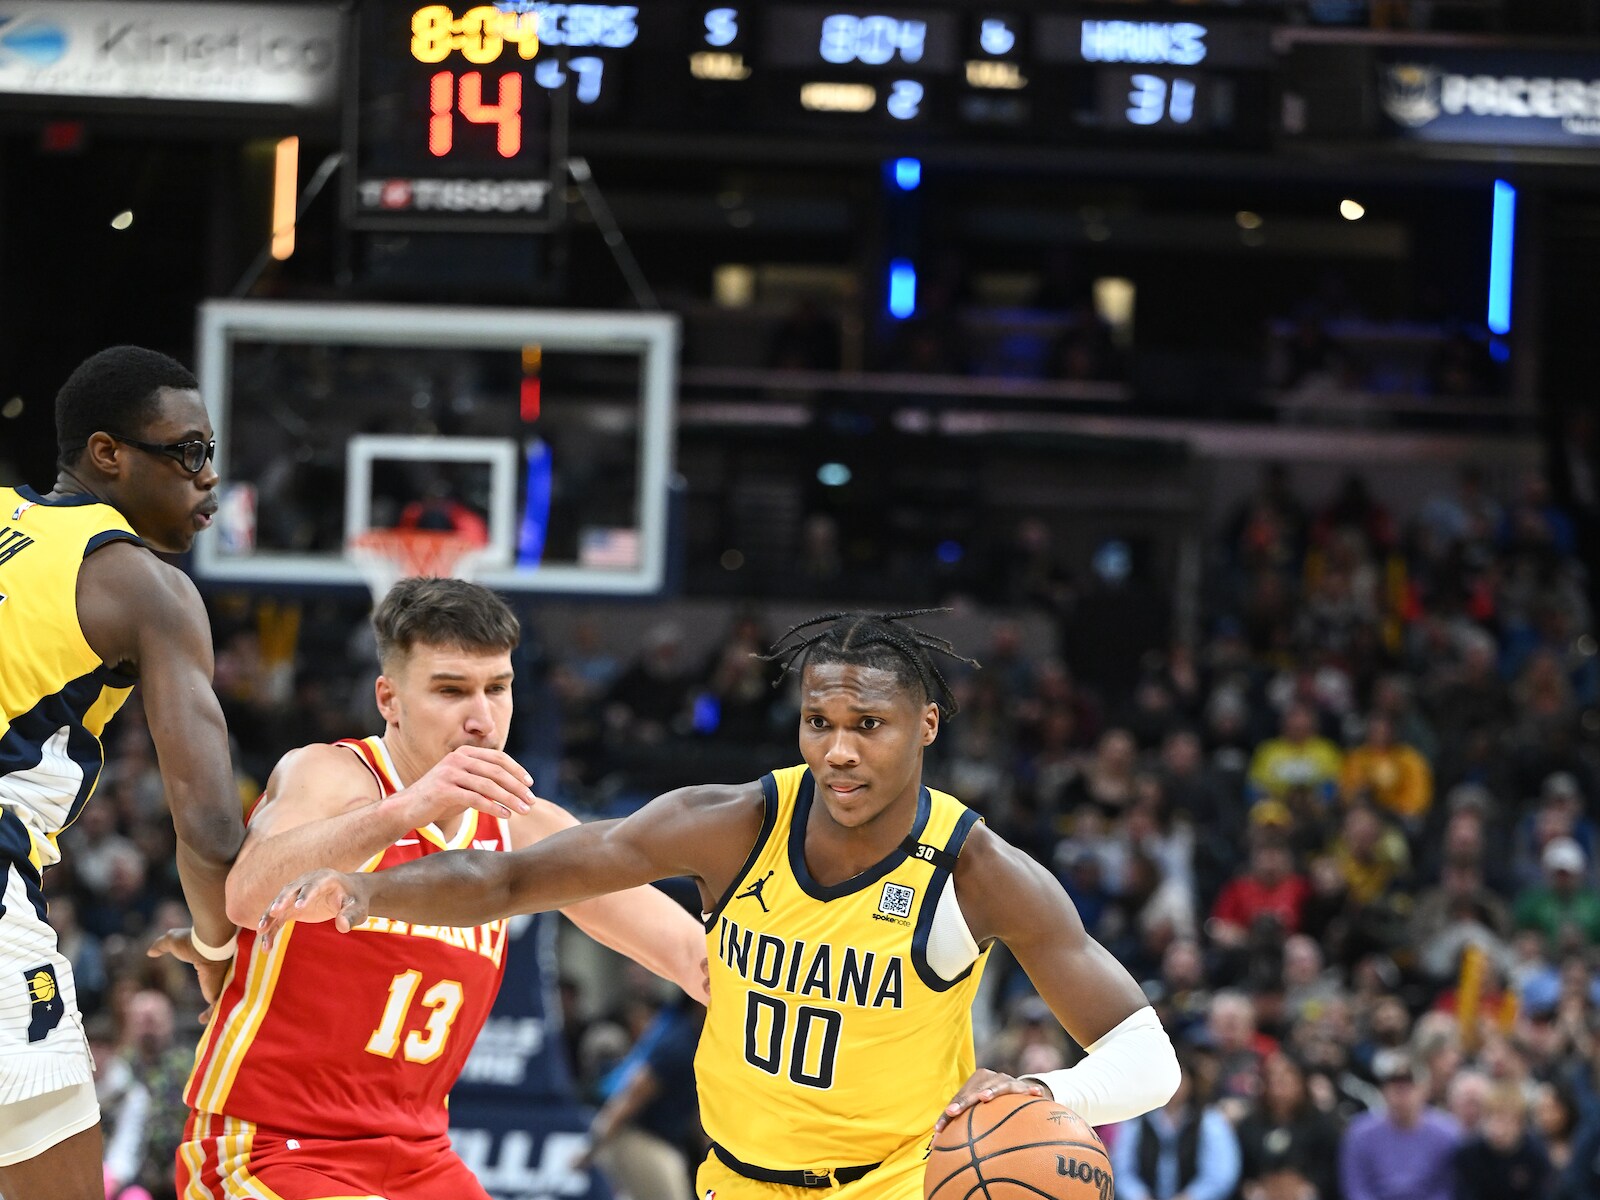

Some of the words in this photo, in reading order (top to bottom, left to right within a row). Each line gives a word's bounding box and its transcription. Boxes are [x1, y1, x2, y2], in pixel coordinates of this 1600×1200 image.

[93, 18, 336, 75] Kinetico
[411, 5, 539, 64] 8:04
[429, 71, 522, 158] 14
[1125, 74, 1196, 125] 31
[916, 846, 935, 861] 30
[872, 912, 911, 927] spokenote
[718, 914, 904, 1010] INDIANA
[364, 968, 465, 1066] 13
[744, 990, 843, 1090] 00
